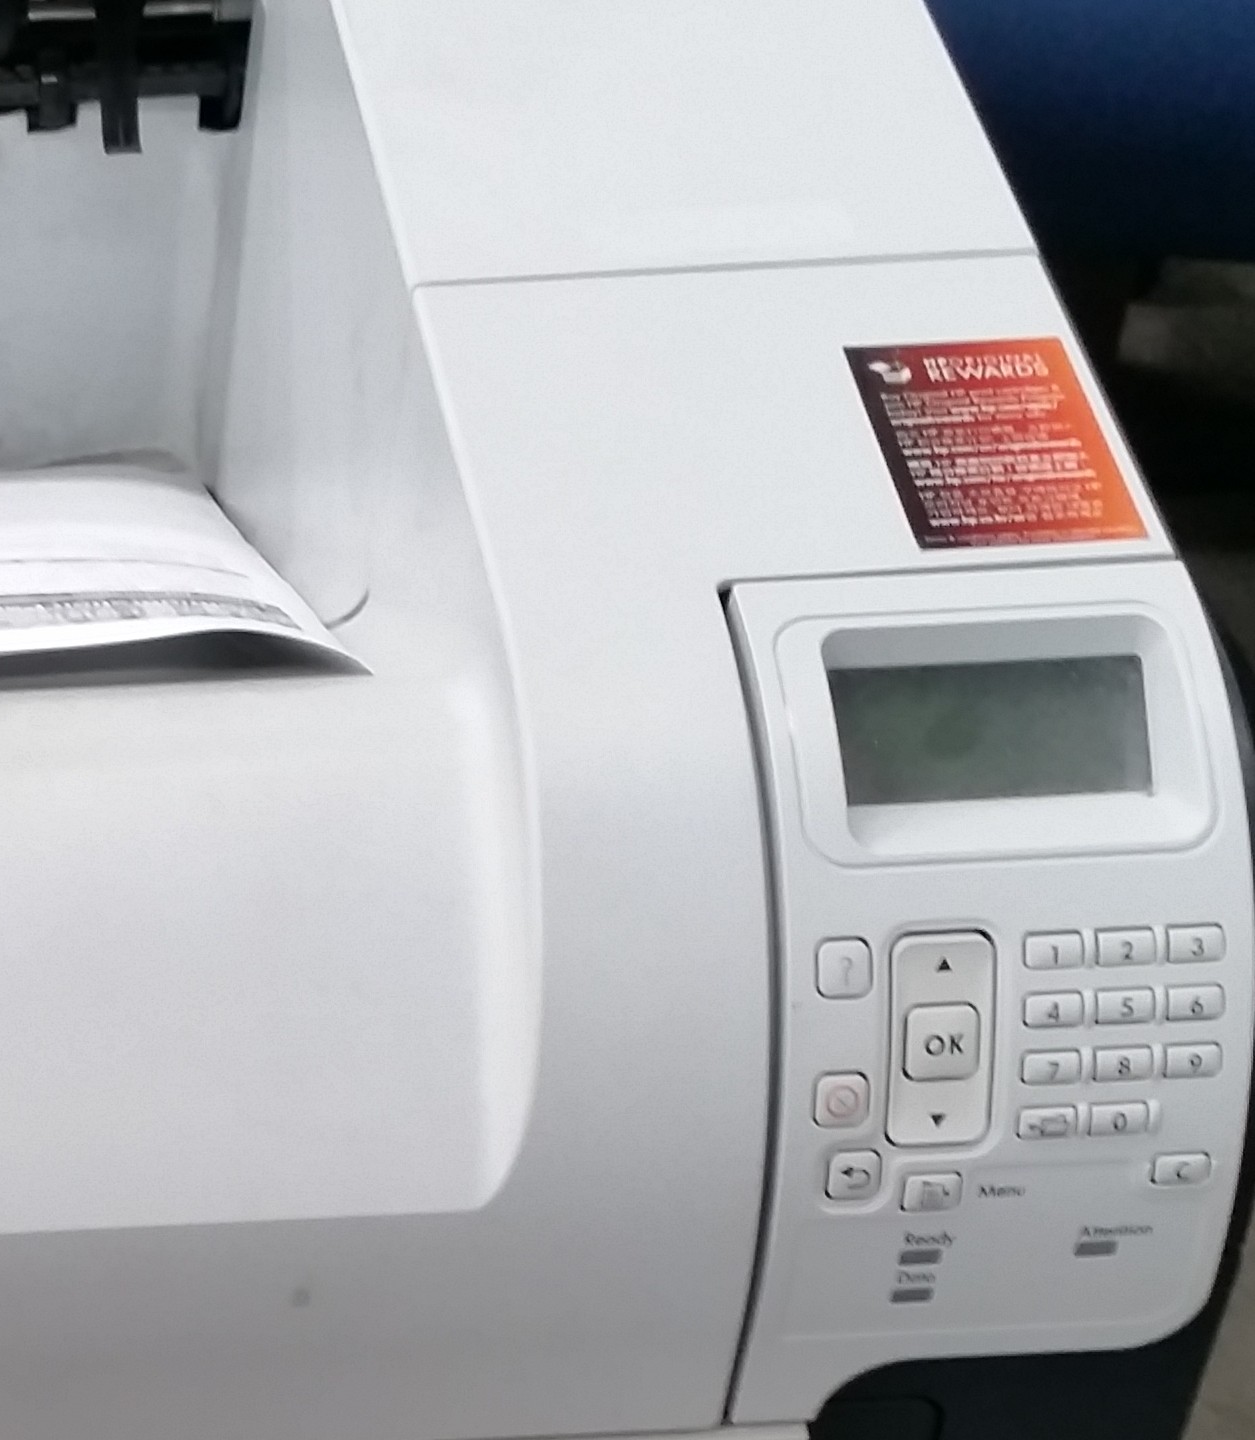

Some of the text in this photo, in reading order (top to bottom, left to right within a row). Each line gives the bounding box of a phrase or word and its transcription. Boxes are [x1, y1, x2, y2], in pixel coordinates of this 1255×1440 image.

[1120, 940, 1134, 961] 2
[1191, 937, 1205, 957] 3
[1047, 995, 1205, 1022] 4 5 6
[924, 1032, 965, 1056] OK
[1047, 1053, 1203, 1079] 7 8 9
